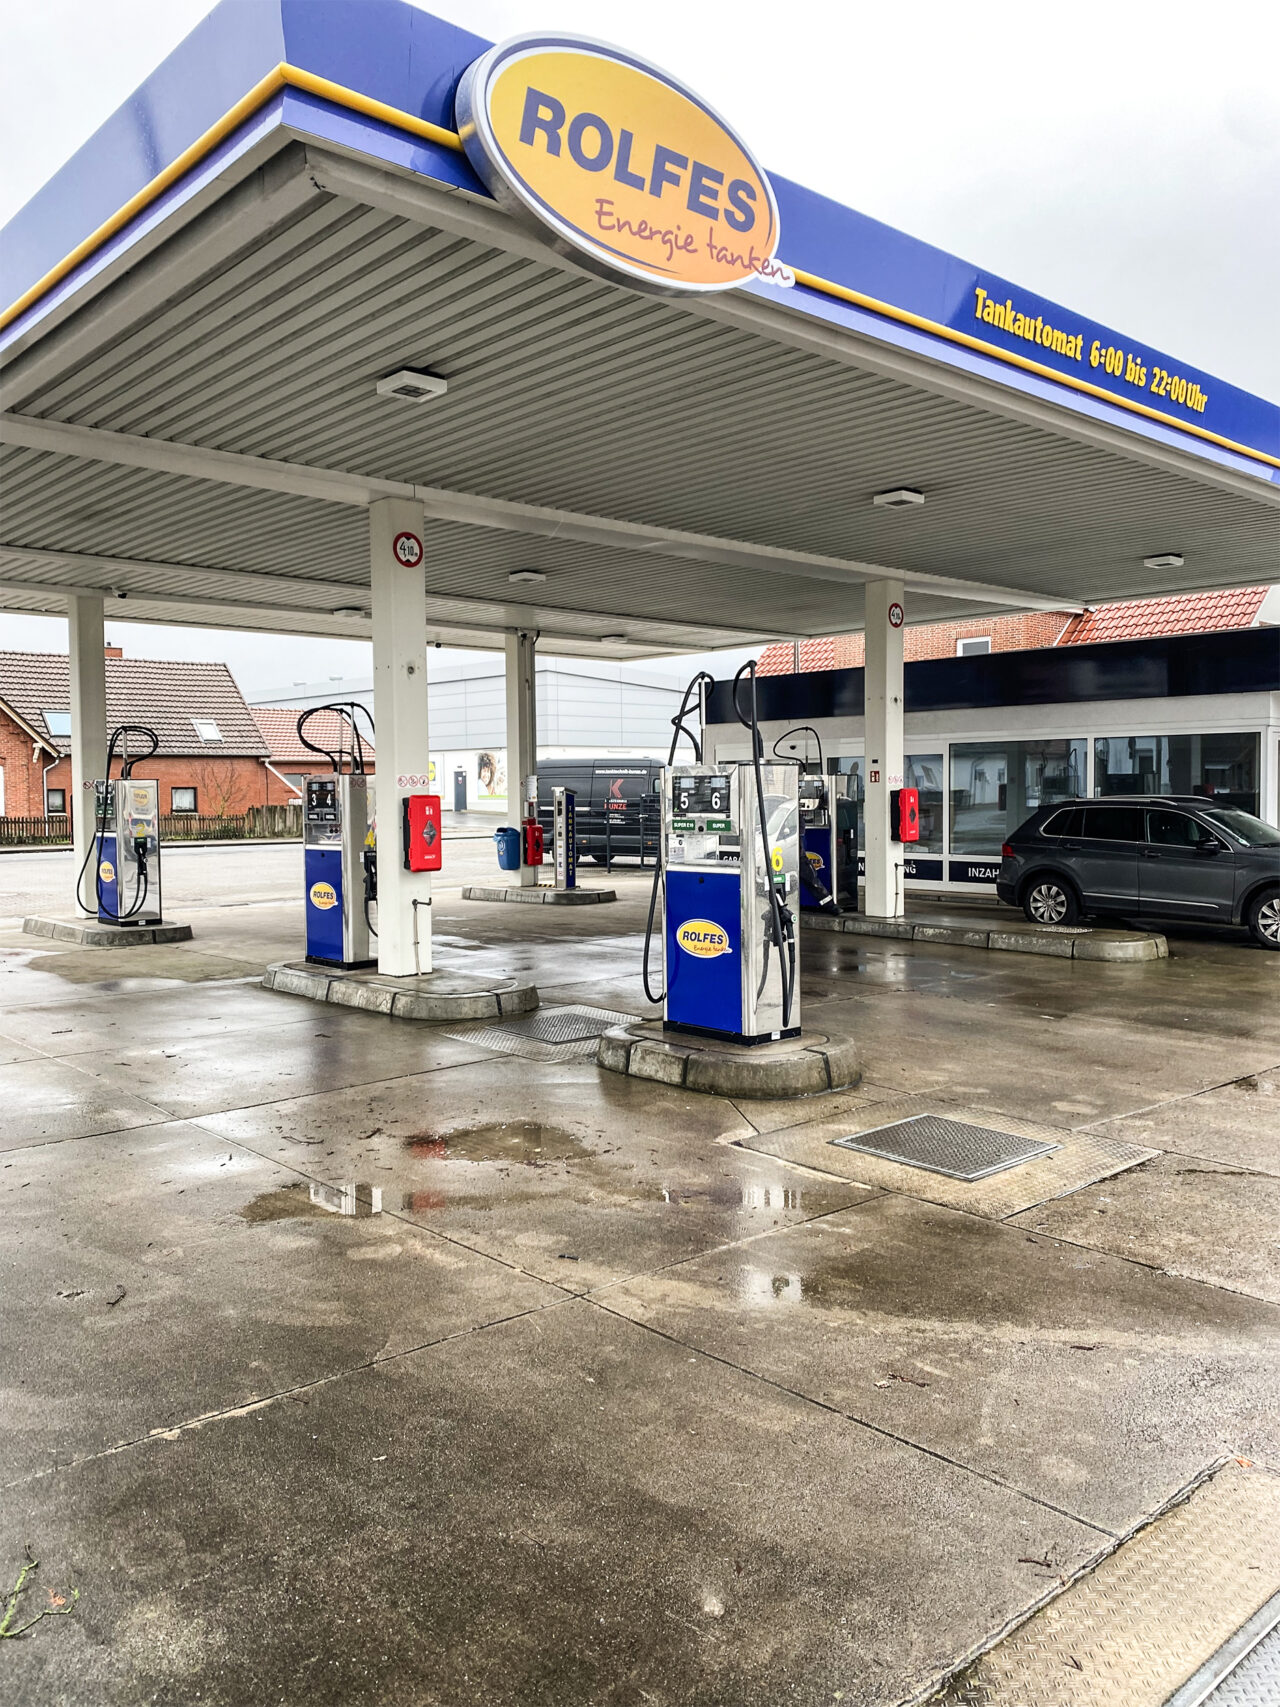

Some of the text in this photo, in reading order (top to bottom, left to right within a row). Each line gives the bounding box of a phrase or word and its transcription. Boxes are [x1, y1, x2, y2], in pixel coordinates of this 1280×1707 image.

[519, 86, 757, 233] ROLFES
[595, 198, 790, 281] Energie tanken
[975, 288, 1208, 413] Tankautomat 6:00 bis 22:00 Uhr
[311, 793, 317, 806] 3
[326, 793, 332, 806] 4
[680, 792, 689, 809] 5
[711, 792, 721, 809] 6
[136, 823, 145, 837] 2
[364, 829, 375, 848] 4
[771, 847, 783, 872] 6
[968, 867, 999, 878] INZAH
[313, 890, 333, 900] ROLFES
[682, 931, 724, 945] ROLFES
